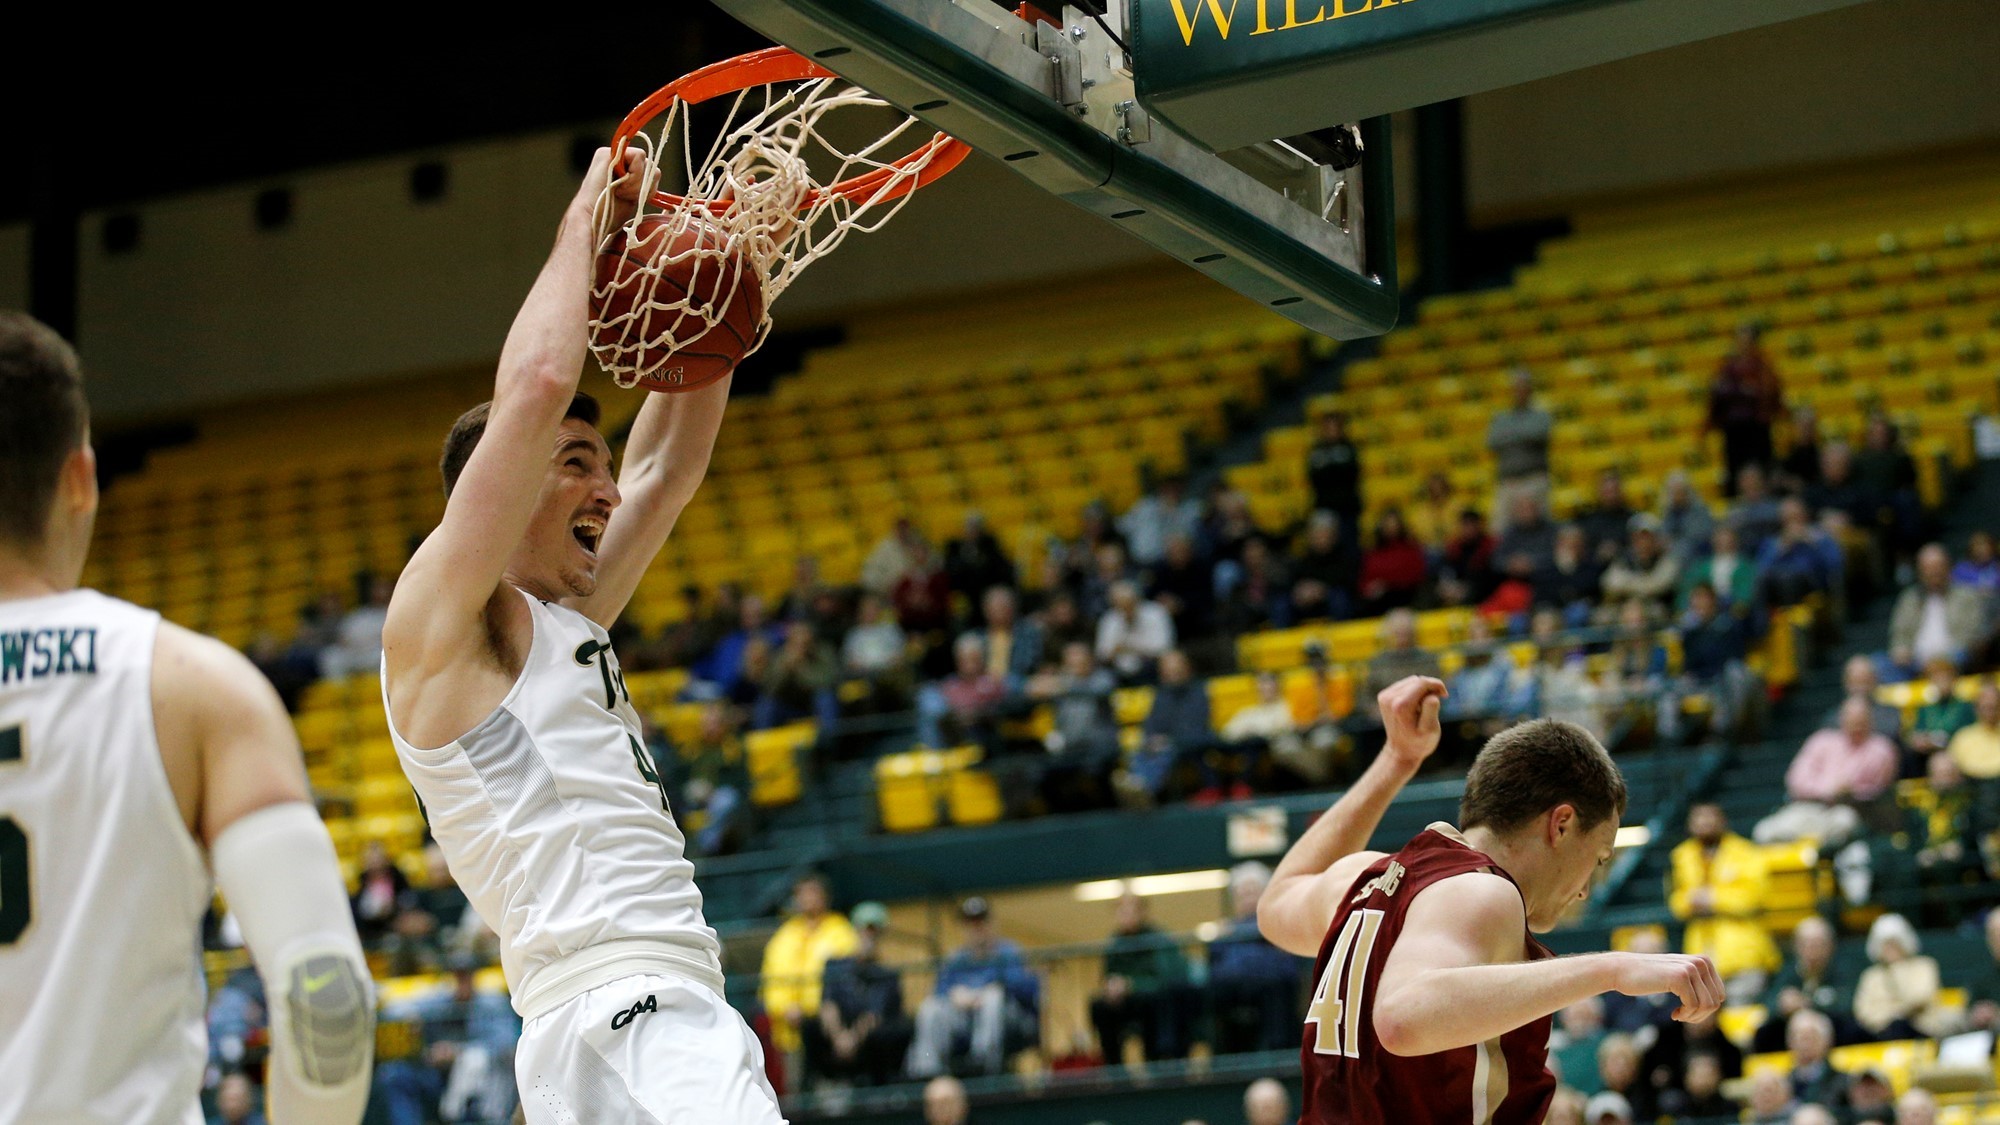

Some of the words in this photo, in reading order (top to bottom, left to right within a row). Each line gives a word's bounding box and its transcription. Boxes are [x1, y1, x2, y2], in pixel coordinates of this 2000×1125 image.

[645, 366, 684, 385] NG
[0, 629, 97, 684] WSKI
[1304, 908, 1386, 1059] 41
[611, 995, 658, 1031] CAA
